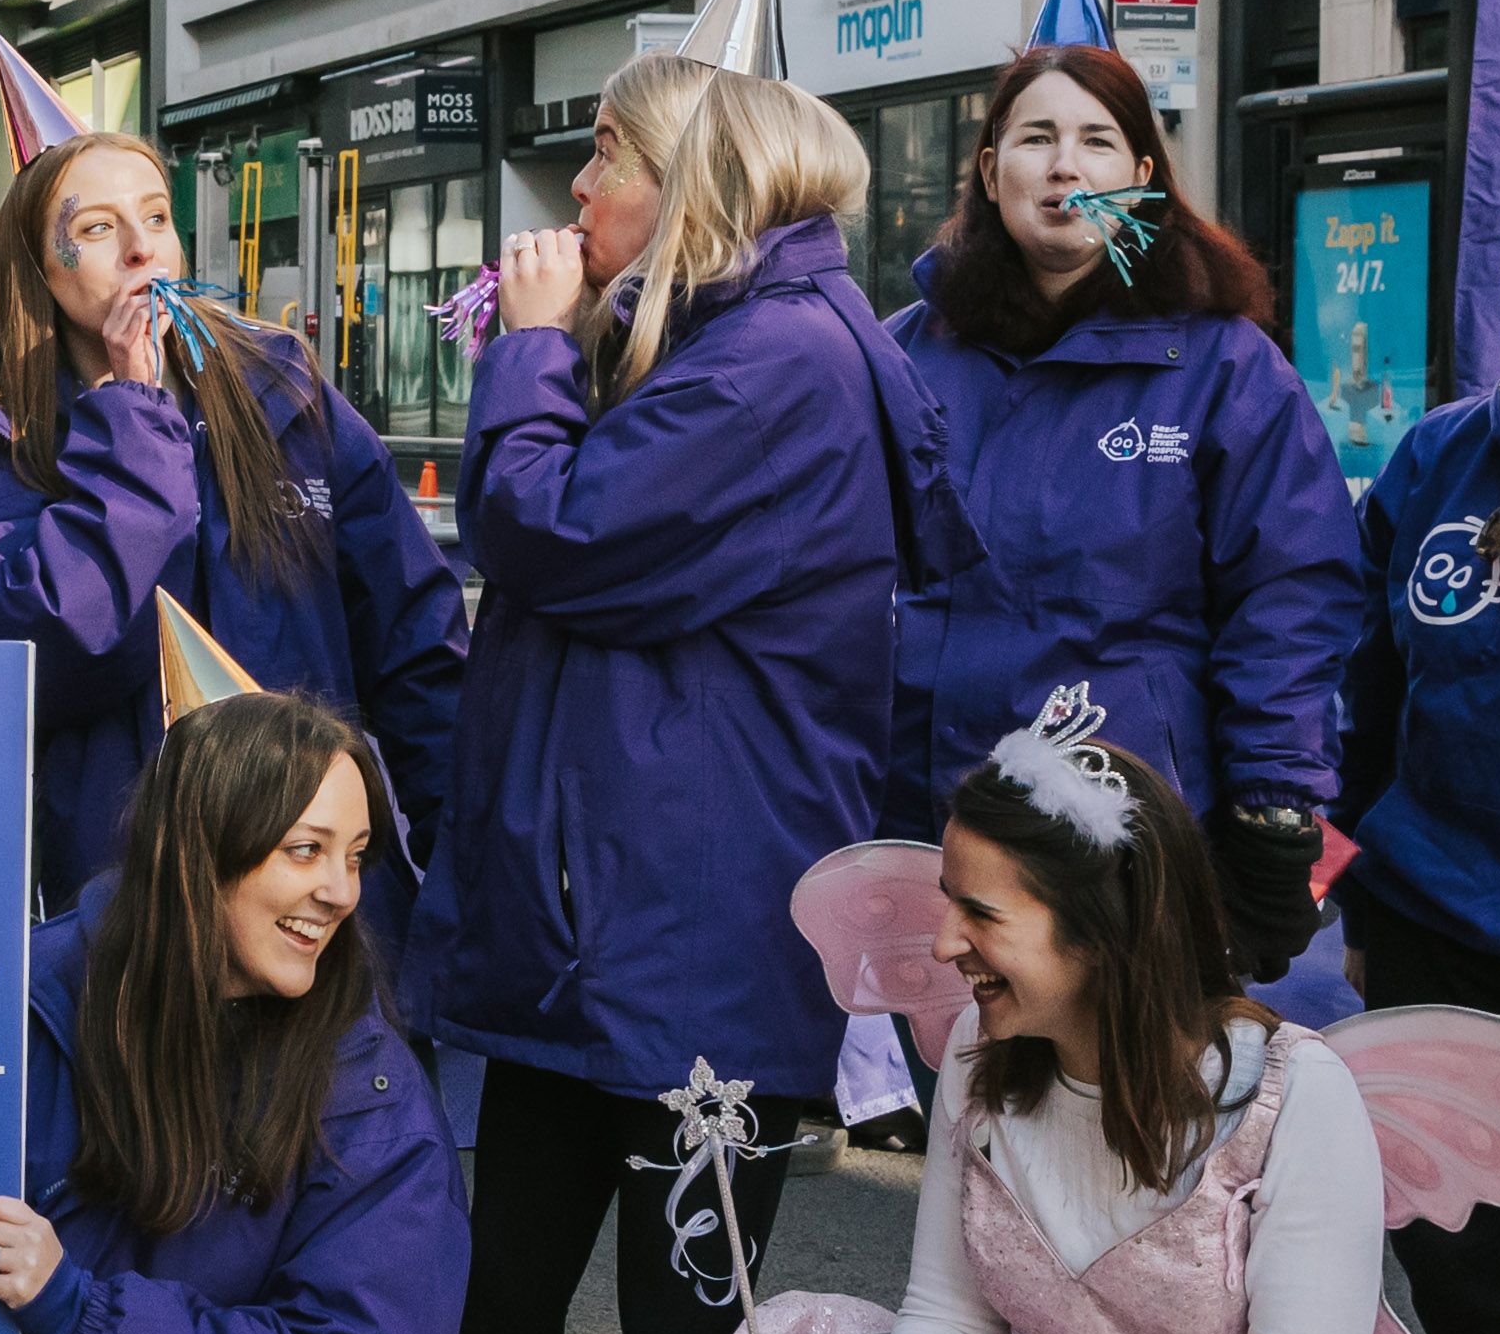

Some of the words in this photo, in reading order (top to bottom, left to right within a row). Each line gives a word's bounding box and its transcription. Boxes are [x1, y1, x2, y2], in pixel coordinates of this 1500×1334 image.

[427, 93, 473, 107] MOSS
[350, 101, 392, 142] MOSS
[427, 109, 478, 123] BROS.
[1325, 216, 1376, 255] Zapp
[1380, 212, 1400, 245] it.
[1336, 259, 1386, 295] 24/7.
[1146, 455, 1181, 464] CHARITY
